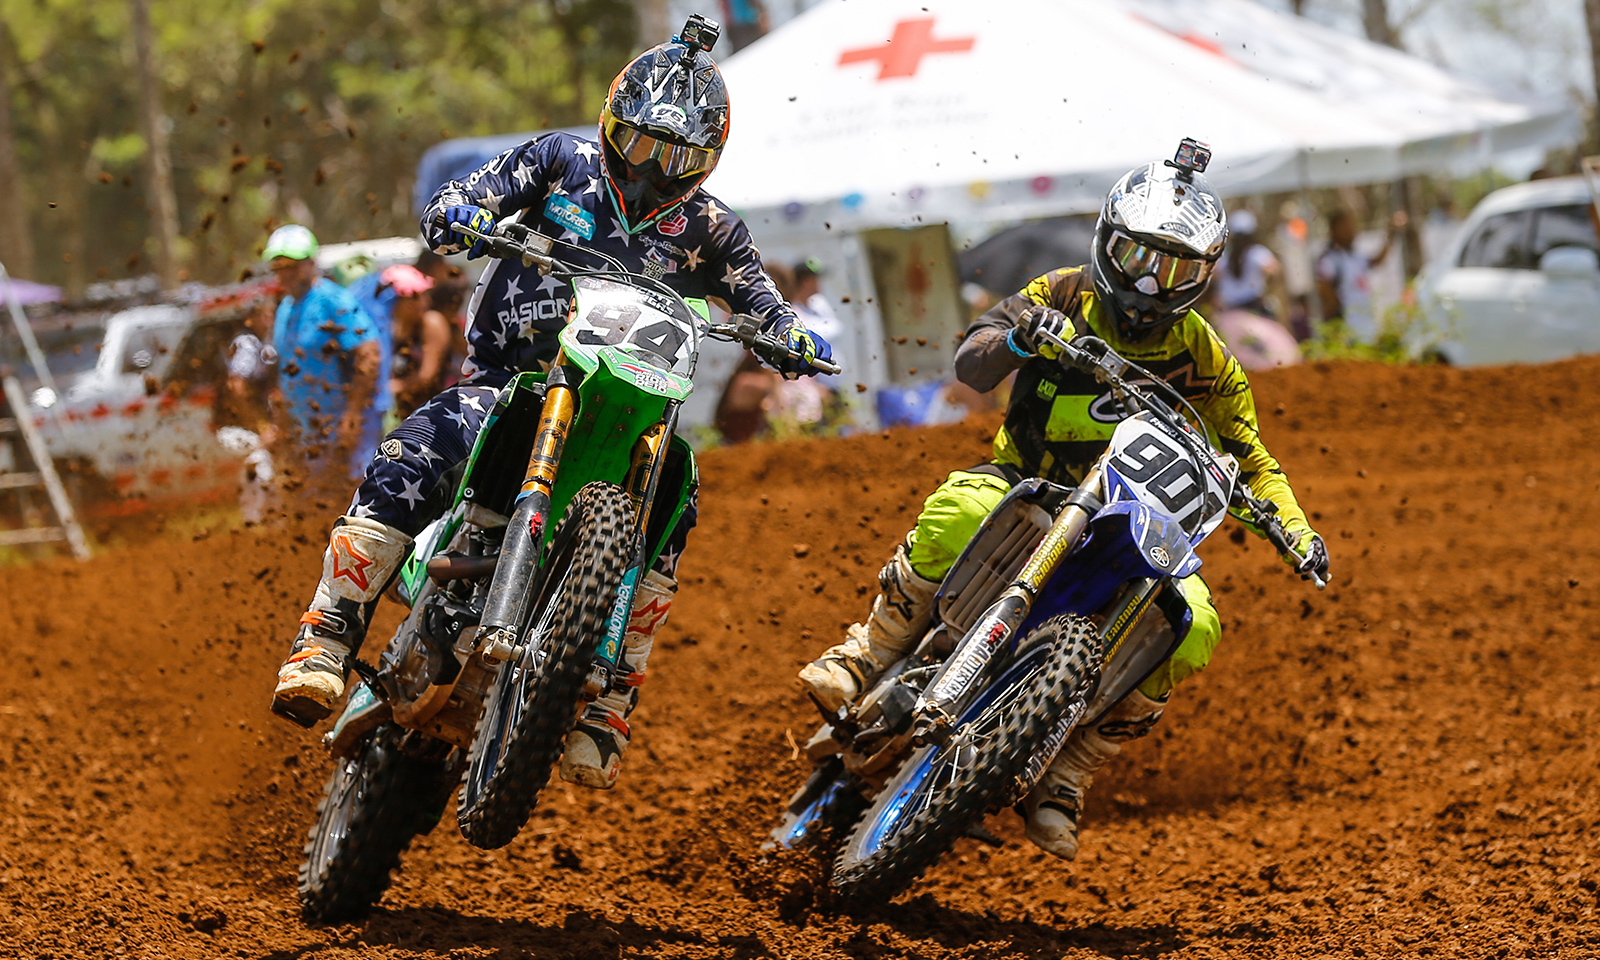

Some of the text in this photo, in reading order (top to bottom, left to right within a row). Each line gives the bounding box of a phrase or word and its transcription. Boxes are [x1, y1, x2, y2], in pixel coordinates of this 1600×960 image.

[549, 202, 592, 232] MOTOREX
[576, 303, 690, 368] 94
[1109, 432, 1225, 534] 901
[1032, 536, 1068, 588] Factory
[608, 582, 632, 641] MOTOREX
[1105, 595, 1141, 642] Factory
